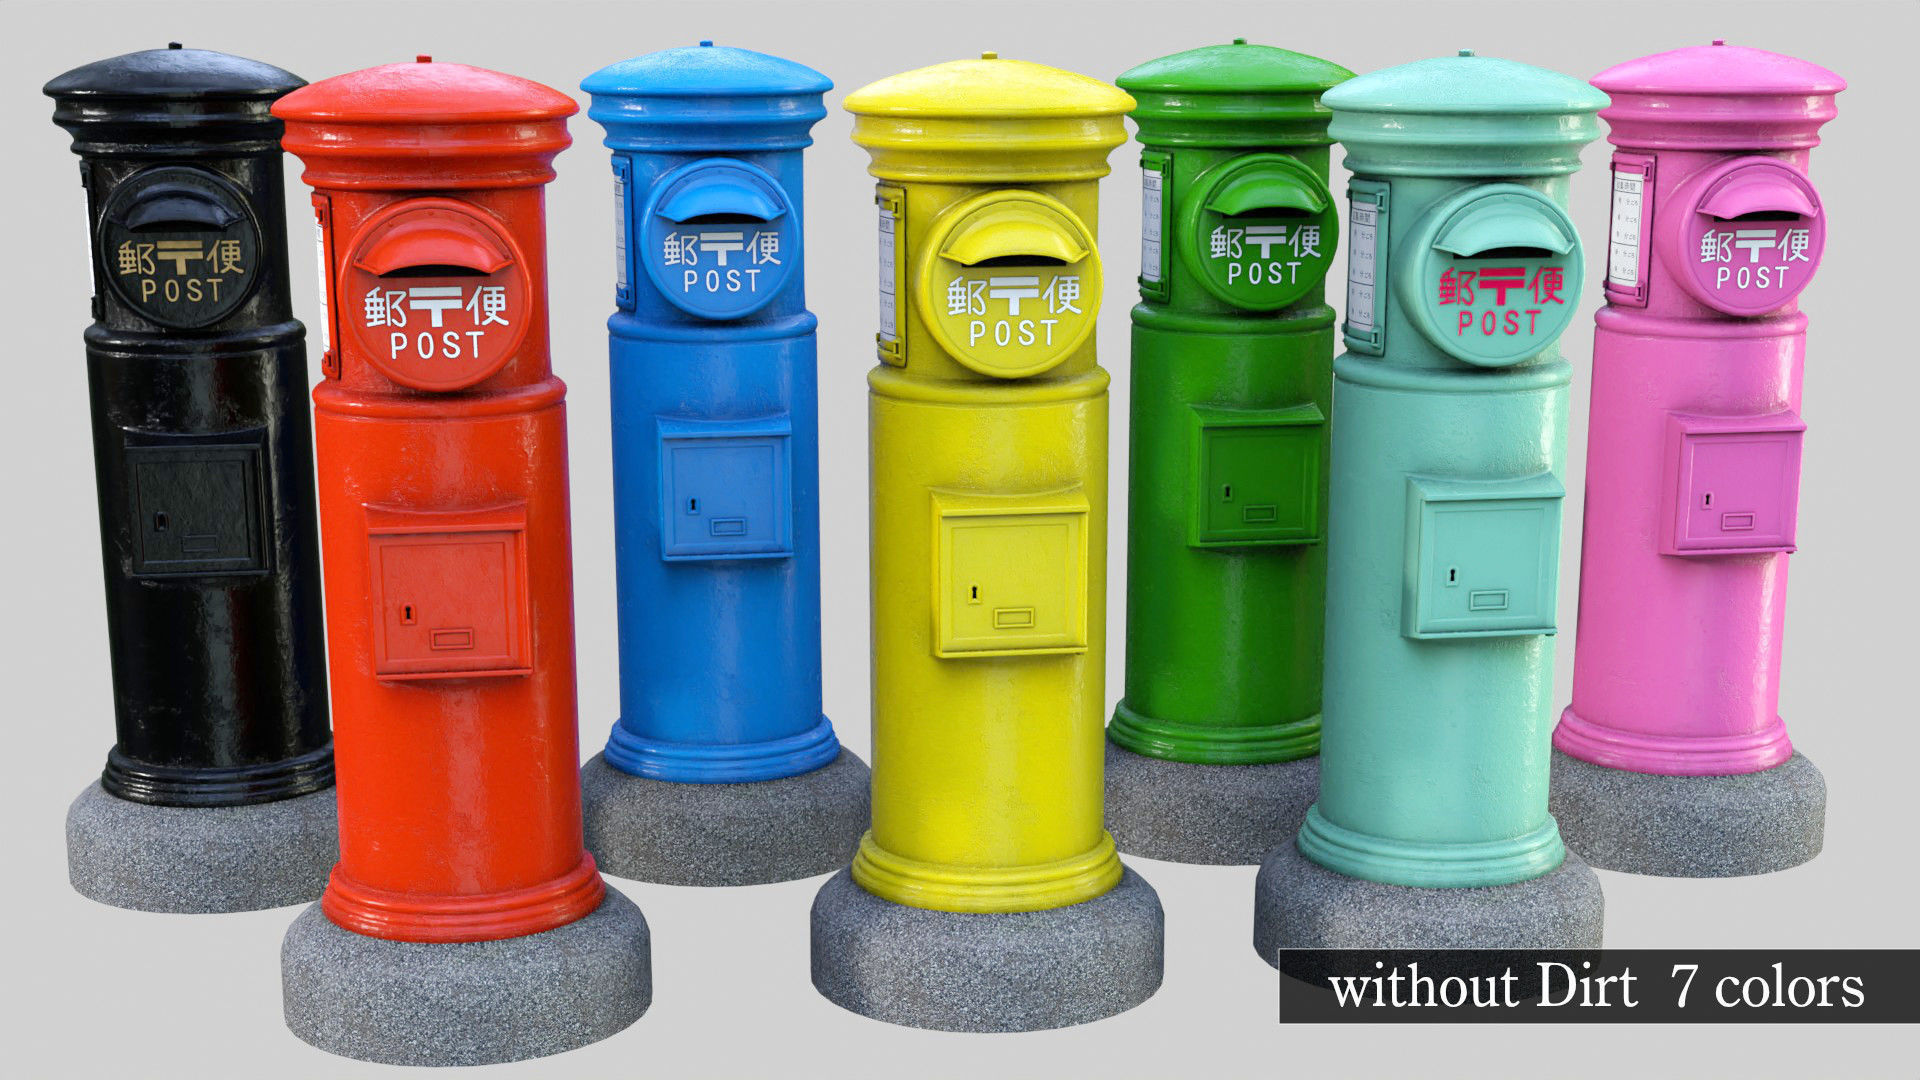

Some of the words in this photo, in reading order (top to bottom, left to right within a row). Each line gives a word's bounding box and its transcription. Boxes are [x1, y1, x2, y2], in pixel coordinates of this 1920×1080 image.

[684, 269, 761, 293] POST
[1228, 261, 1302, 285] POST
[1716, 266, 1790, 290] POST
[141, 278, 223, 303] POST
[969, 319, 1059, 347] POST
[1457, 309, 1542, 336] POST
[390, 331, 485, 360] POST
